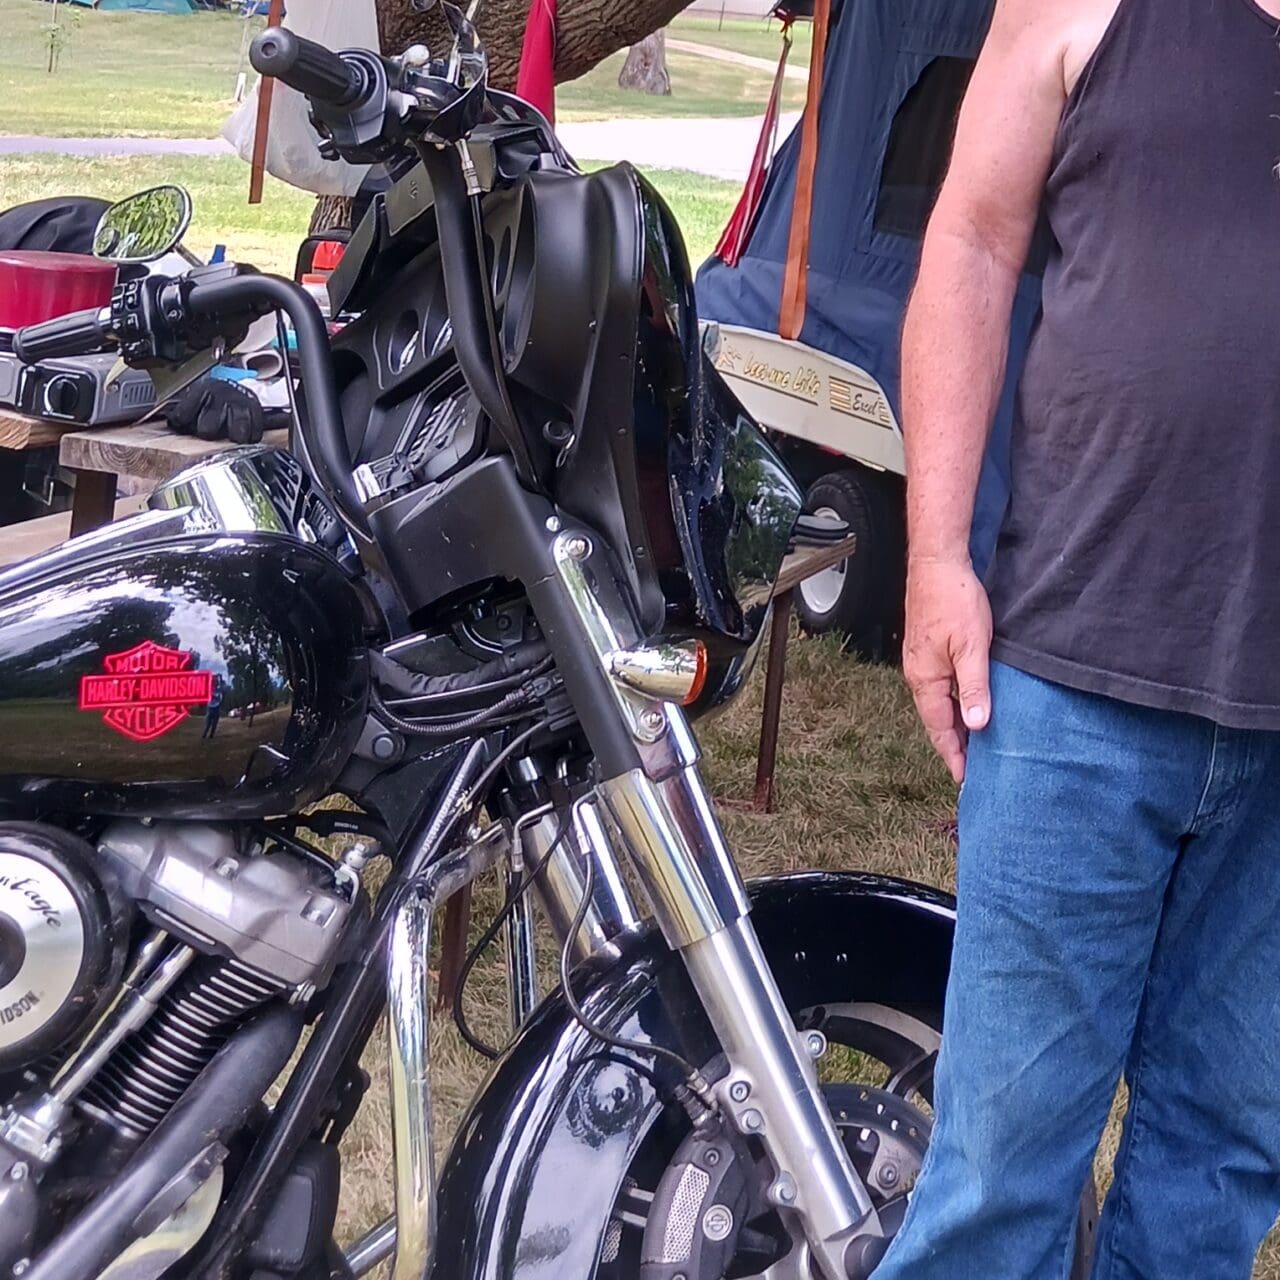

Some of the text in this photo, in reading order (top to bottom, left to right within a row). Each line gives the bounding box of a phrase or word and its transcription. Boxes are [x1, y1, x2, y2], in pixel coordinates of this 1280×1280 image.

[852, 393, 879, 417] Excel
[116, 649, 179, 673] MOTOR
[87, 675, 206, 702] HARLEY-DAVIDSON
[114, 706, 177, 734] CYCLES
